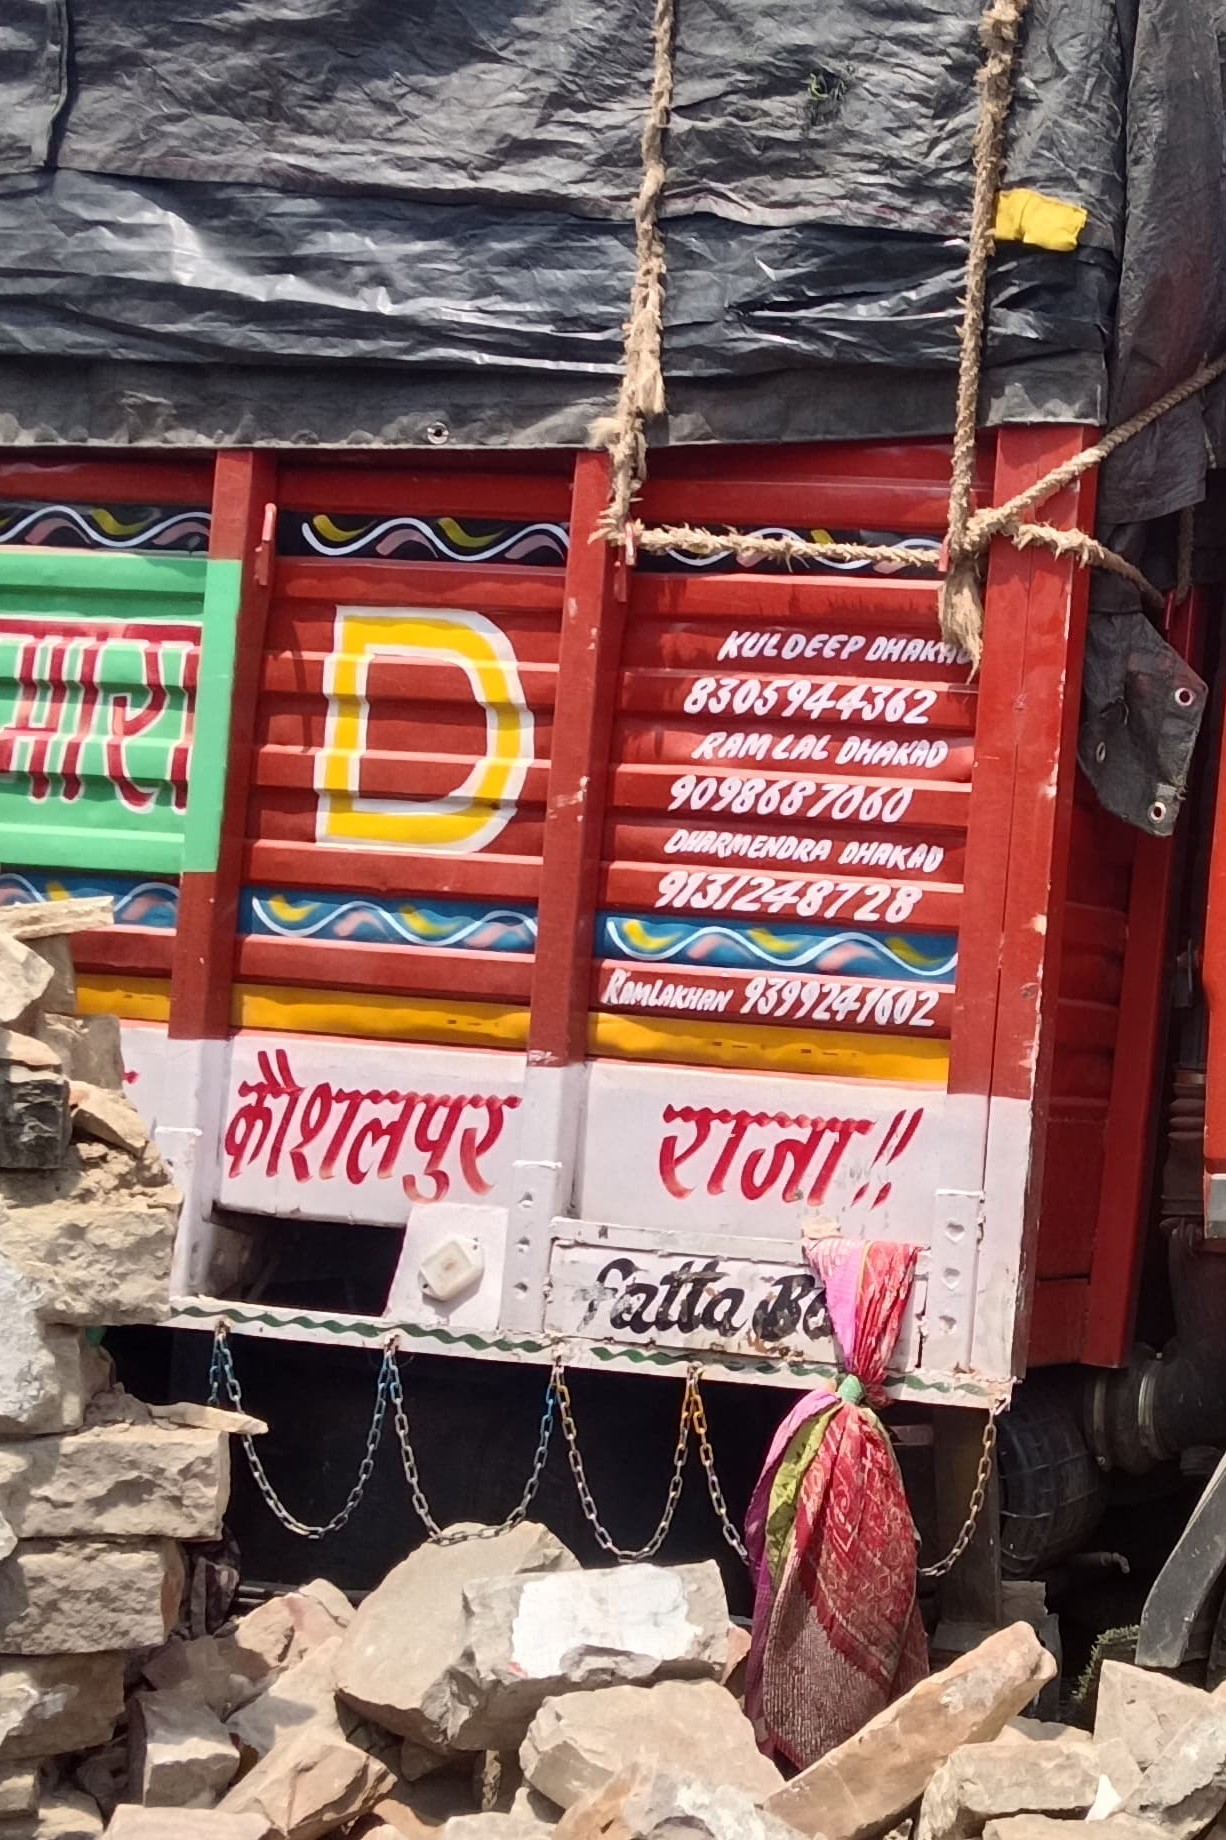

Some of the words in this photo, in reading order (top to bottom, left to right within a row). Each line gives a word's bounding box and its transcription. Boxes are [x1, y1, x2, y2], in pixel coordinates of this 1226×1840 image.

[683, 677, 938, 725] 8305944362
[313, 605, 535, 855] D
[835, 735, 949, 769] DHAKAD
[667, 774, 914, 823] 9098687060
[663, 829, 832, 862] DHARMENDRA
[838, 841, 945, 873] DHAKAD
[654, 870, 924, 923] 9131248728
[224, 1048, 524, 1204] कौशलपुर
